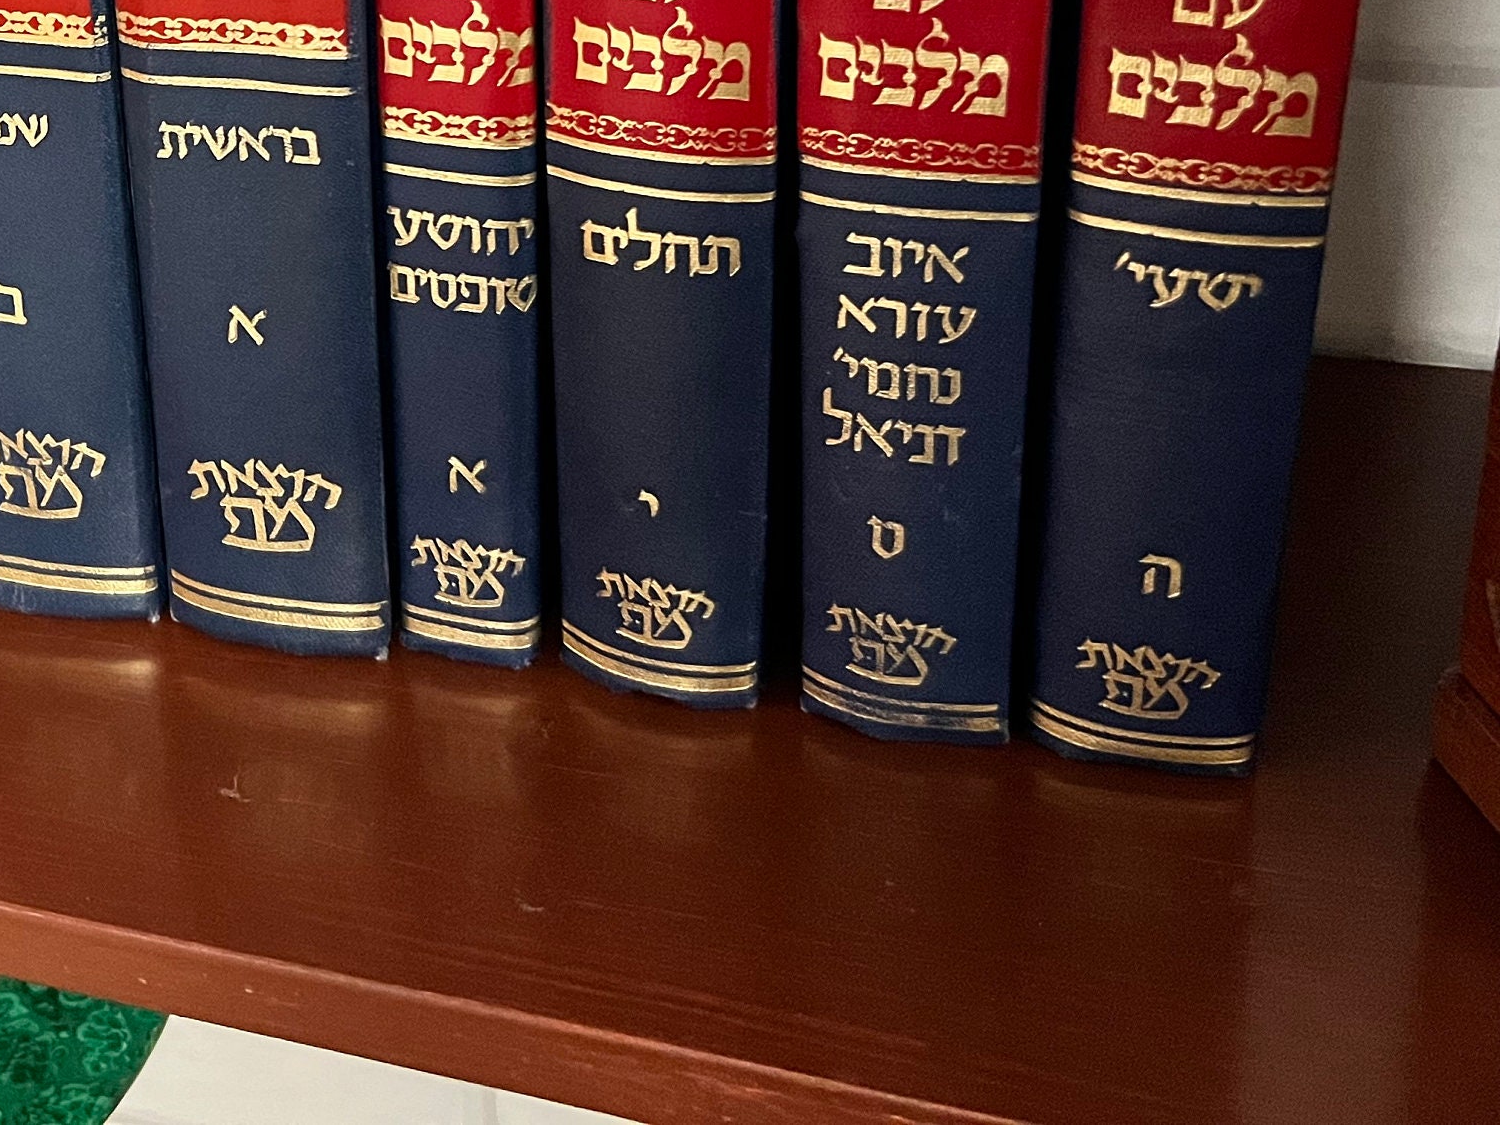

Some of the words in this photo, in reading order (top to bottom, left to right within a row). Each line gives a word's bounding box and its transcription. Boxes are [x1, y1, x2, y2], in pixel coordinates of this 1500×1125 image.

[156, 119, 322, 166] בראשית
[387, 205, 535, 256] יהושע
[580, 206, 741, 277] תהלים
[842, 231, 970, 284] איוב
[387, 261, 538, 314] שופטים
[227, 304, 268, 346] א
[836, 294, 977, 344] עזרא
[821, 387, 967, 467] דניאל
[448, 455, 488, 494] א
[637, 488, 660, 518] י
[866, 514, 905, 560] ט
[1138, 552, 1182, 599] ה
